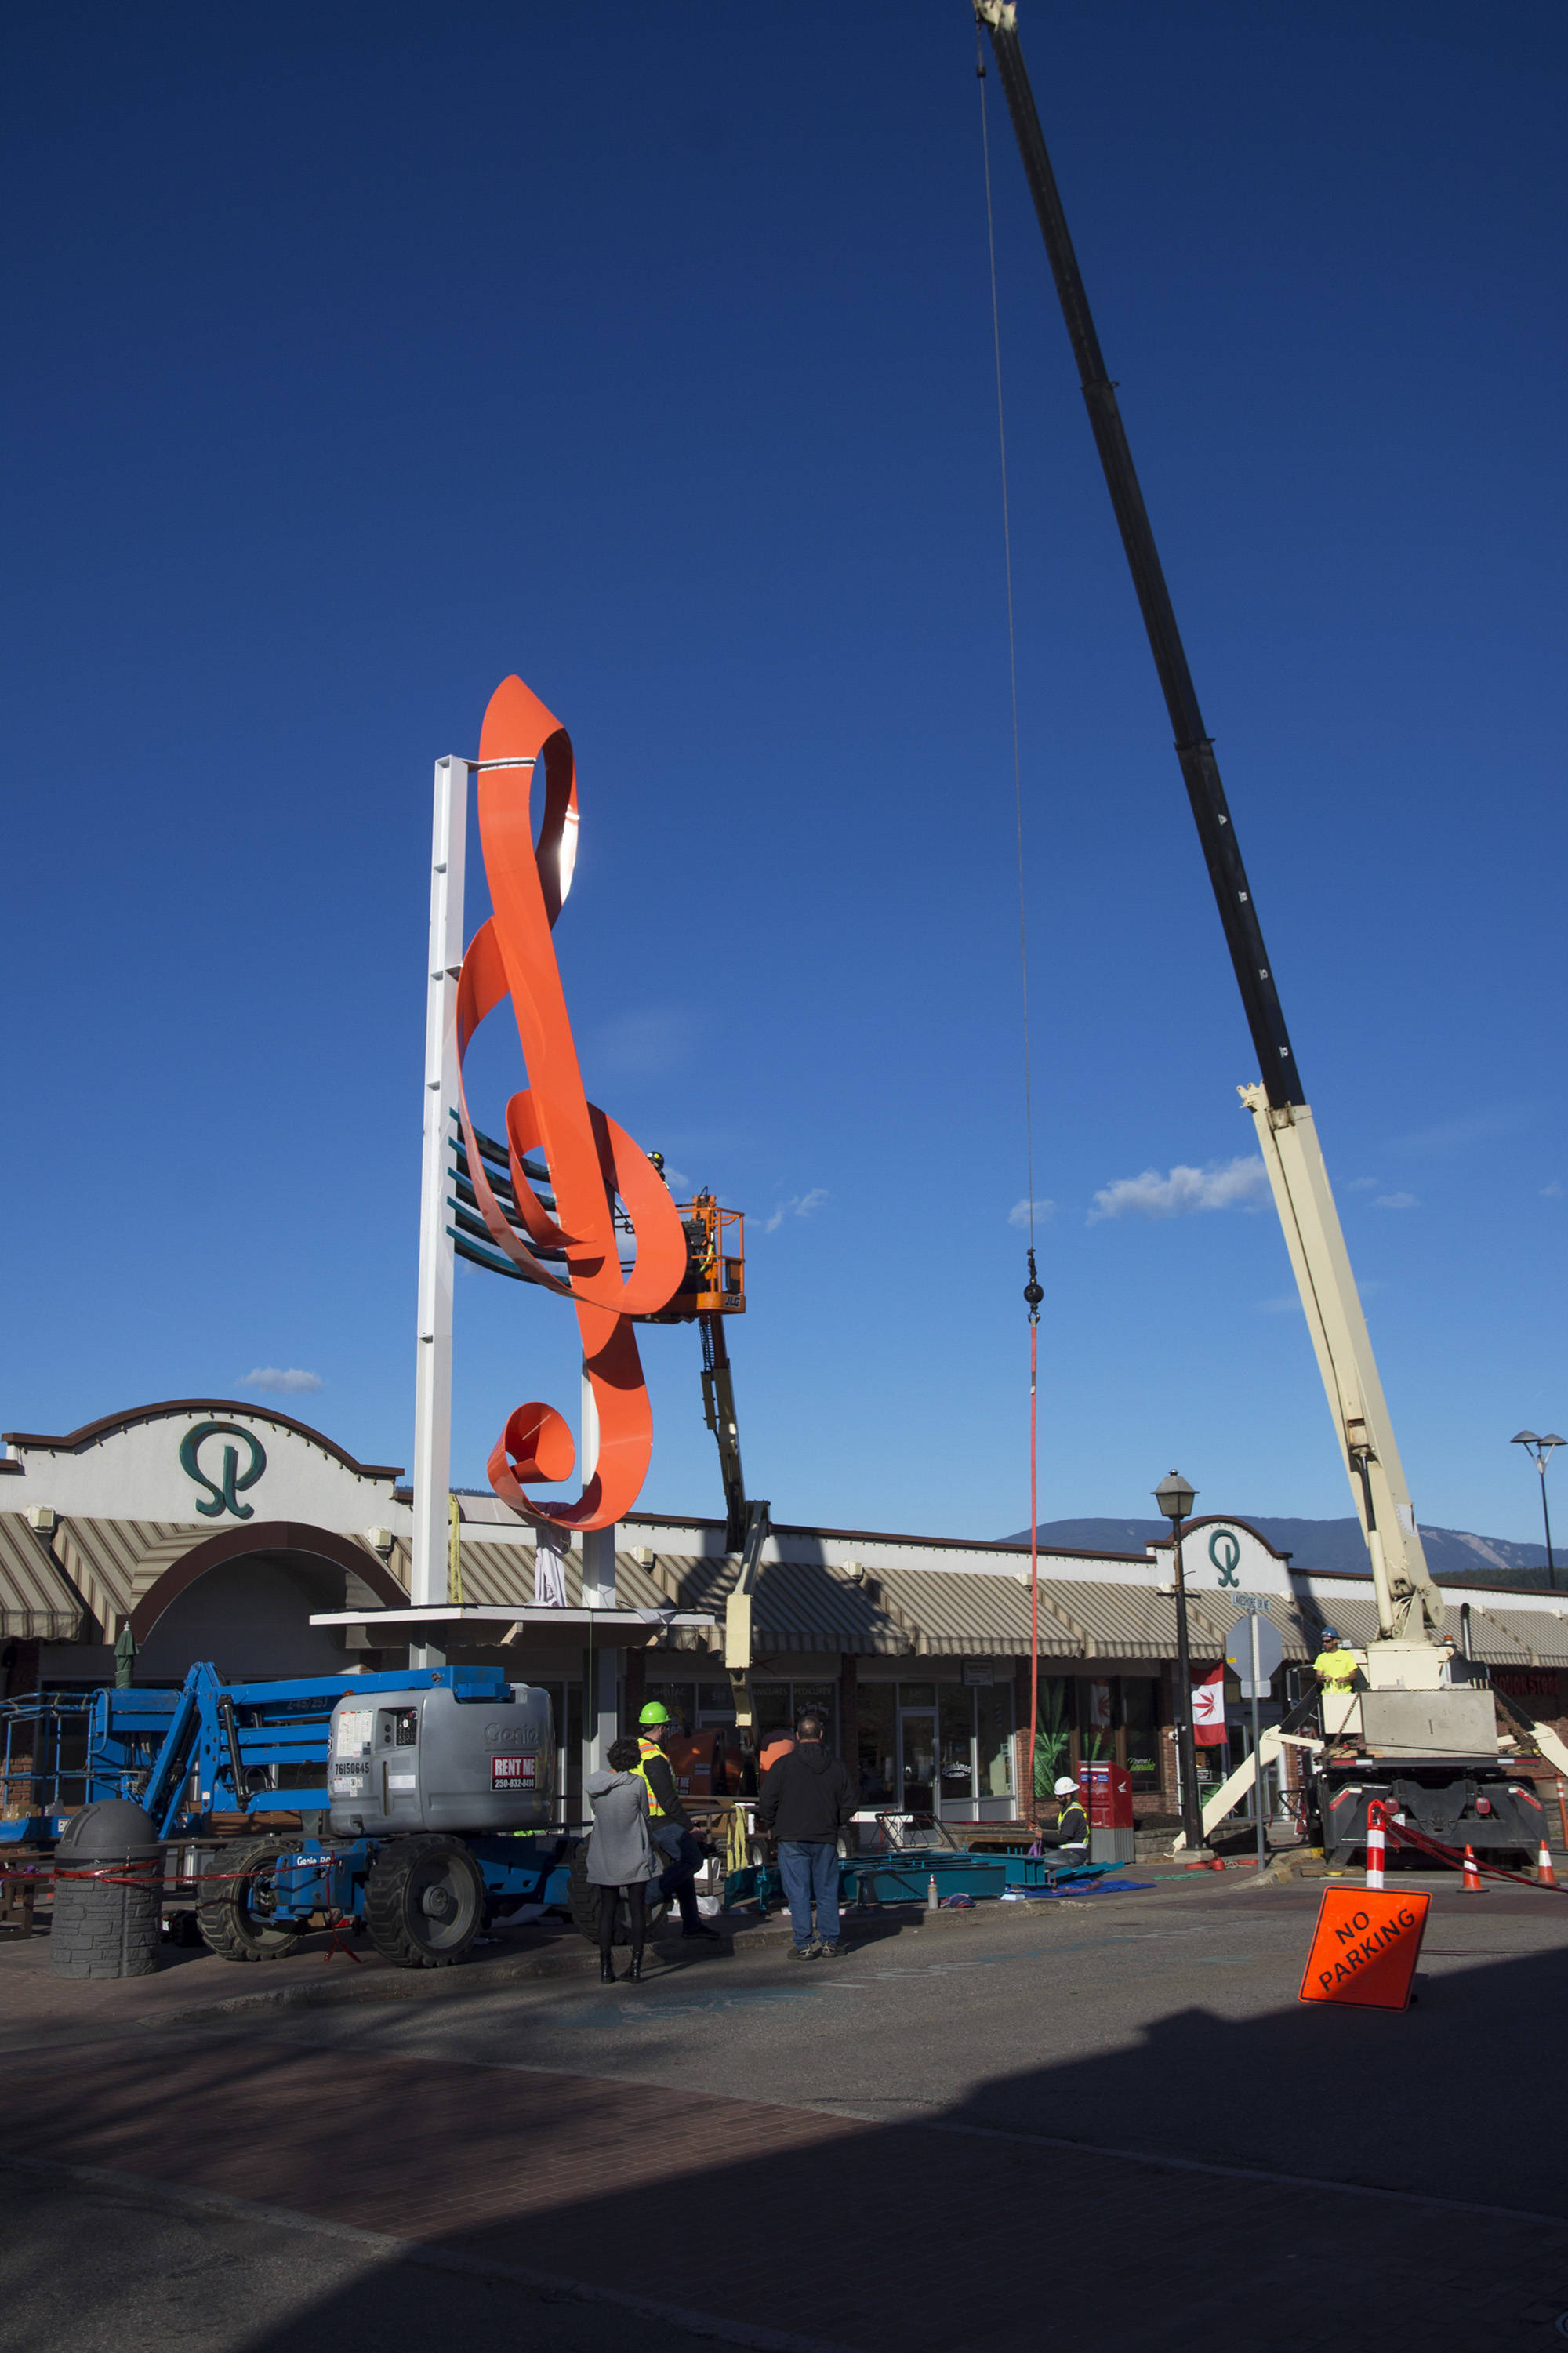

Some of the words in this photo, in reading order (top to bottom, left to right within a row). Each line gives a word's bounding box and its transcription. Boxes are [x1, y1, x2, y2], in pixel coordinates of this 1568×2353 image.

[724, 1295, 741, 1308] JLG
[1232, 1594, 1256, 1606] LAKESHORE
[1257, 1598, 1263, 1608] DR
[1263, 1600, 1269, 1610] NE
[752, 1687, 787, 1696] ANICURES
[1494, 1675, 1528, 1694] IQUOR
[1530, 1676, 1561, 1695] STORE
[483, 1722, 539, 1745] Genie
[335, 1762, 370, 1776] 76150645
[495, 1759, 521, 1776] RENT
[523, 1759, 535, 1776] ME
[495, 1778, 535, 1788] 250-832-8414
[297, 1856, 317, 1866] Genie
[1335, 1912, 1370, 1945] NO
[1319, 1908, 1415, 1992] PARKING
